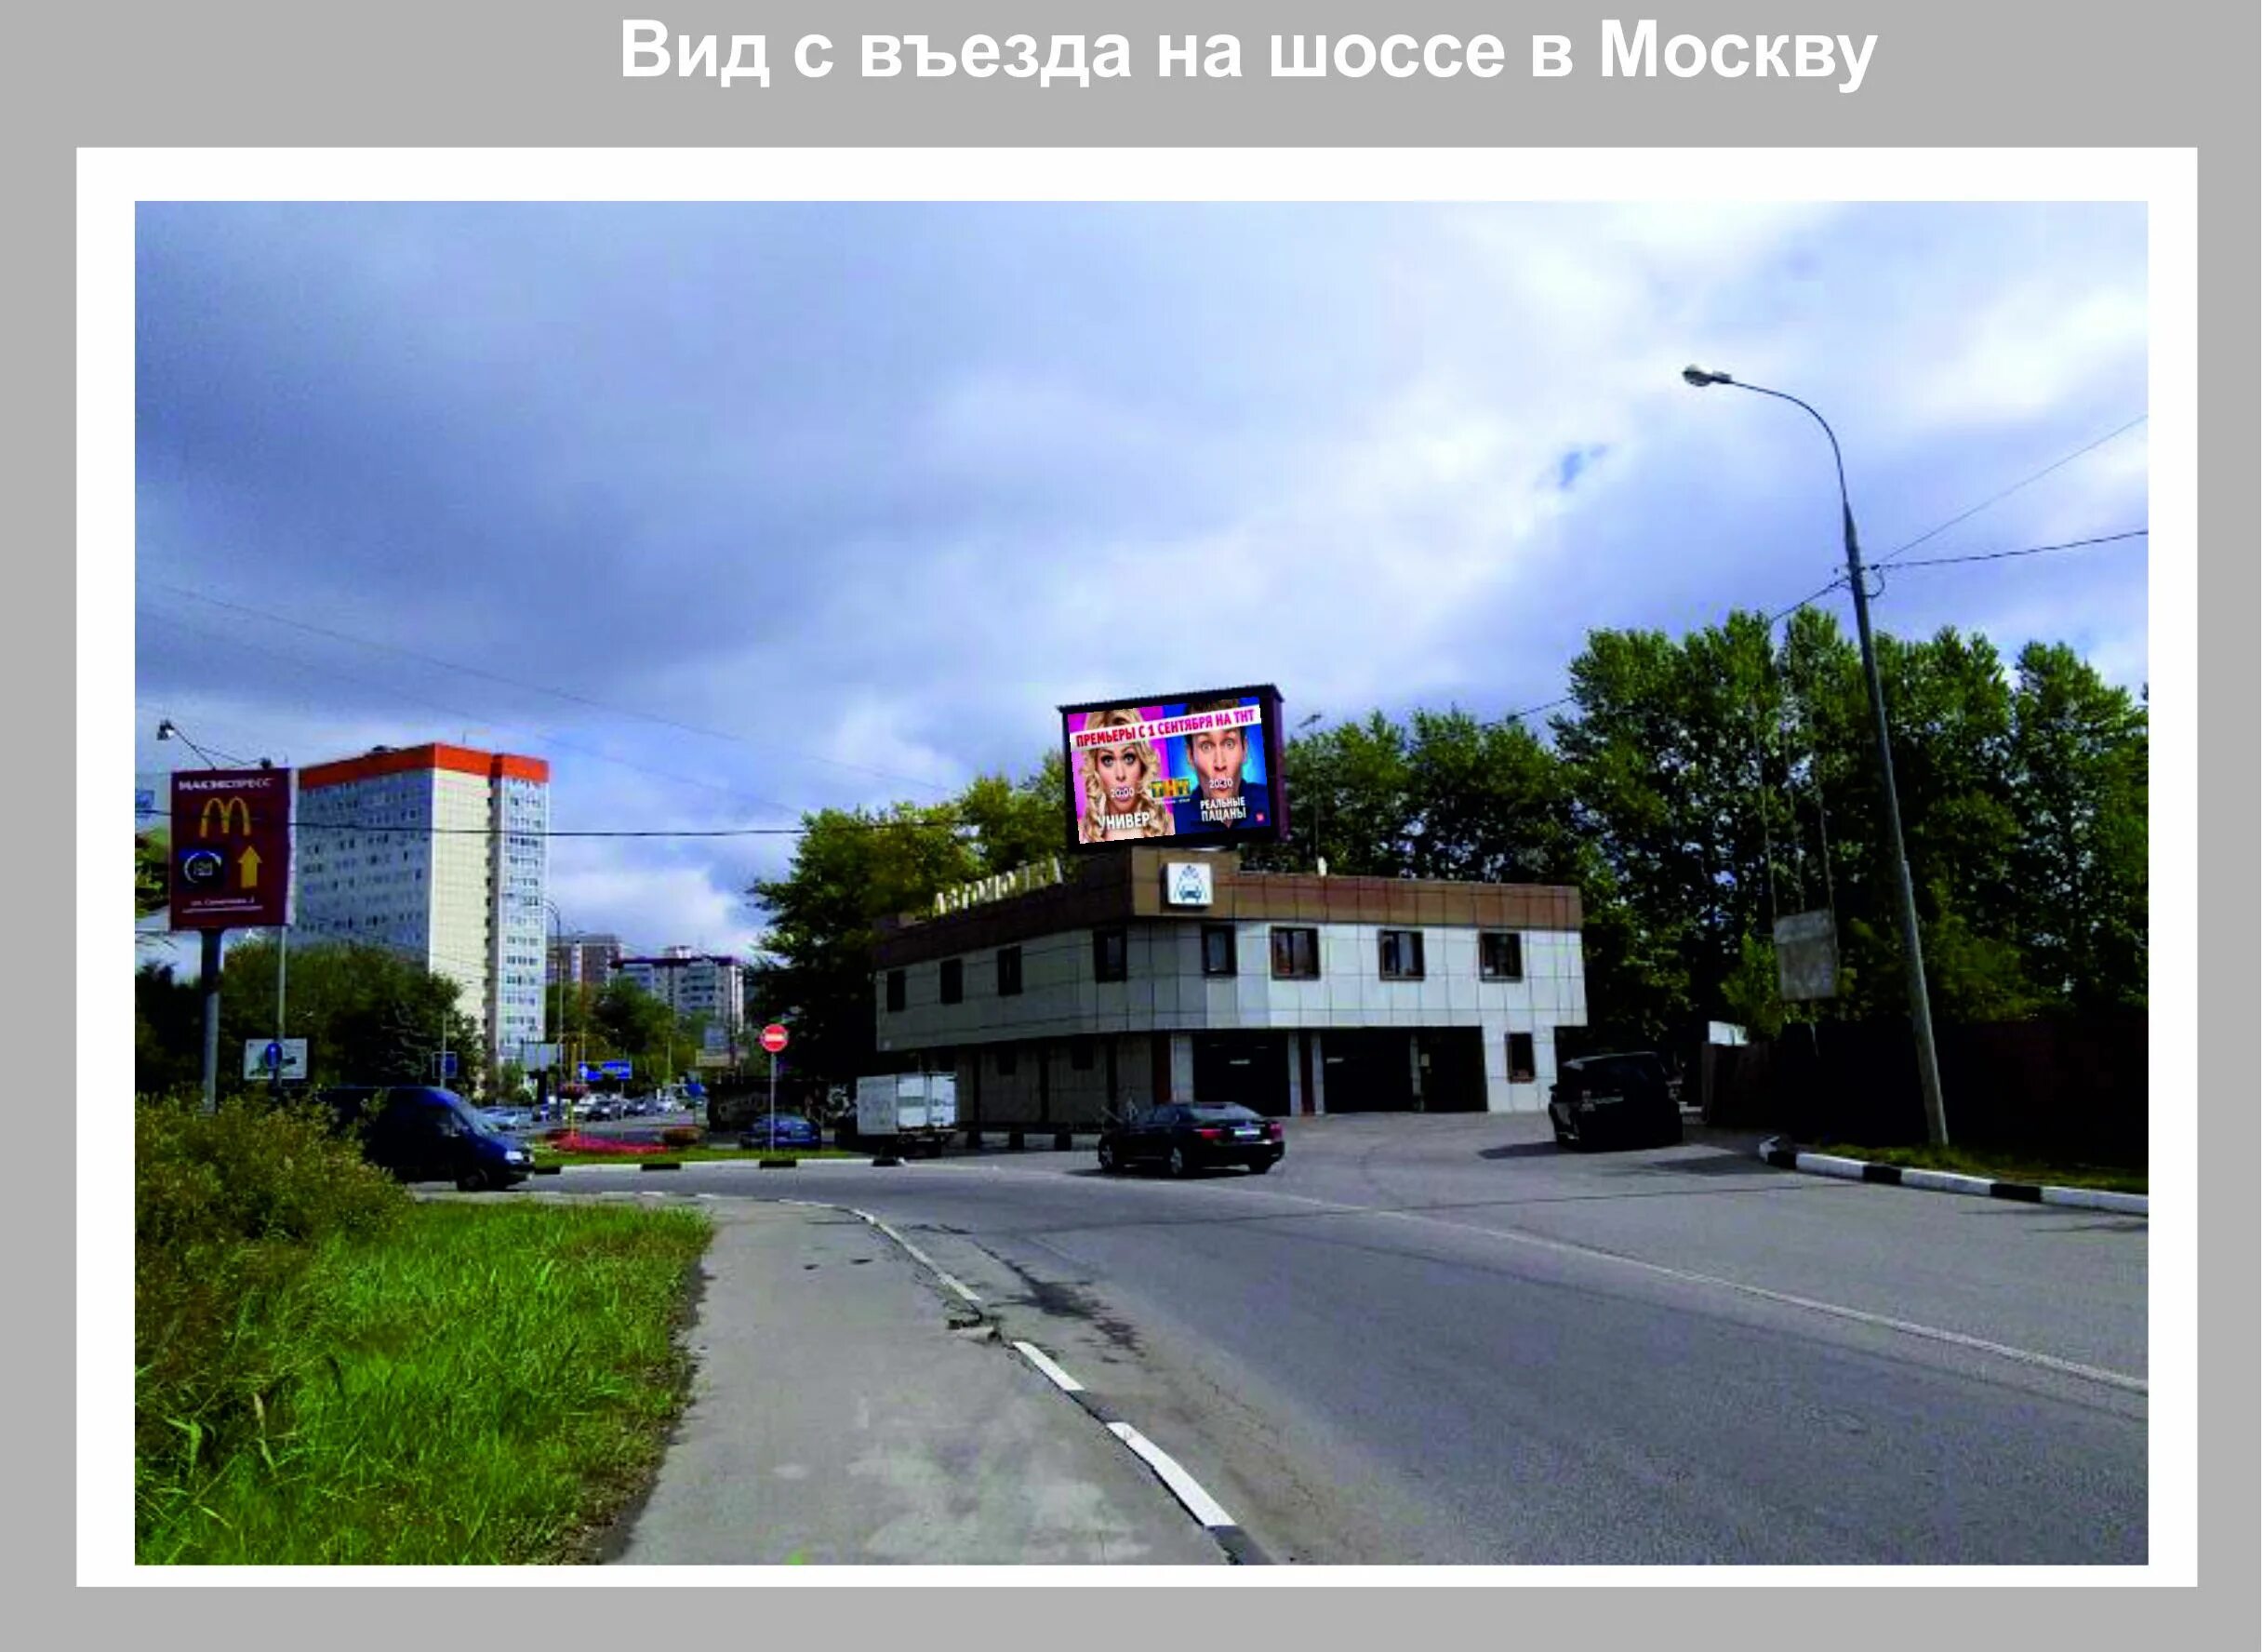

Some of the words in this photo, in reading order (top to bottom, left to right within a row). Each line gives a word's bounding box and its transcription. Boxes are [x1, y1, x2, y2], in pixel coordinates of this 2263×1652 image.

[1076, 727, 1137, 747] ПРЕМЬЕРЫ
[1138, 726, 1146, 739] С
[1148, 725, 1155, 736] 1
[1158, 715, 1213, 735] СЕНТЯБРЯ
[1216, 713, 1232, 726] НА
[1233, 710, 1255, 724] ТНТ
[1150, 779, 1191, 798] ТНТ
[1209, 778, 1233, 789] 20:30
[1111, 787, 1135, 798] 20:00
[1200, 796, 1246, 810] РЕАЛЬНЫЕ
[1098, 812, 1151, 830] УНИВЕР
[1201, 806, 1247, 823] ПАЦАНЫ
